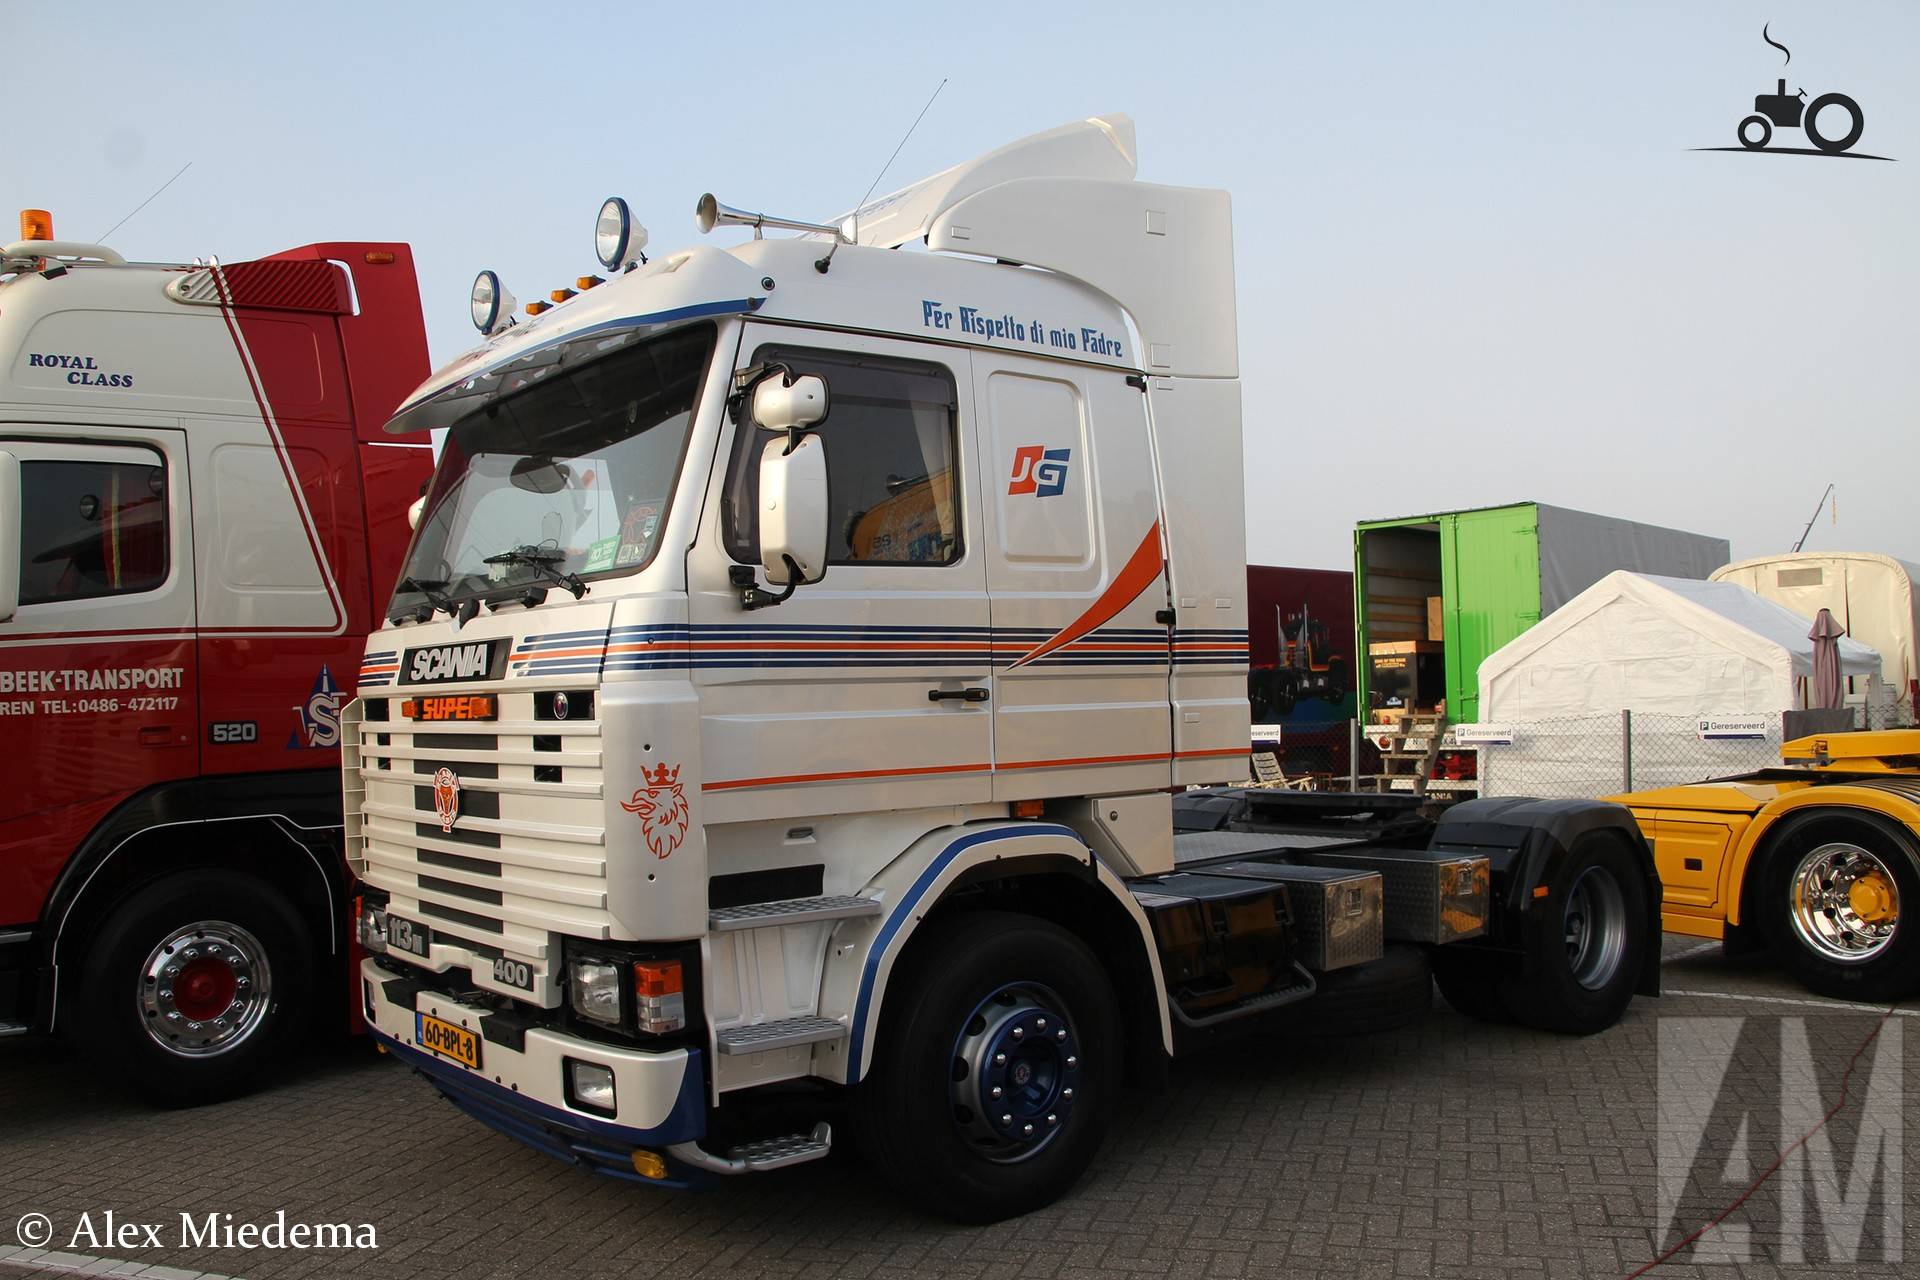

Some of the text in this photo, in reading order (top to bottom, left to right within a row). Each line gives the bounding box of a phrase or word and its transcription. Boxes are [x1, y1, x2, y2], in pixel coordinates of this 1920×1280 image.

[922, 300, 1123, 357] Per Rispetto di mio Padre
[29, 353, 98, 370] ROYAL
[67, 371, 133, 388] CLASS
[410, 643, 488, 681] SCANIA
[213, 723, 256, 742] 520
[1466, 728, 1512, 736] Gereserveerd
[1711, 721, 1765, 730] Gereserveerd
[494, 958, 528, 987] 400
[425, 1021, 474, 1062] 60-BPL-8
